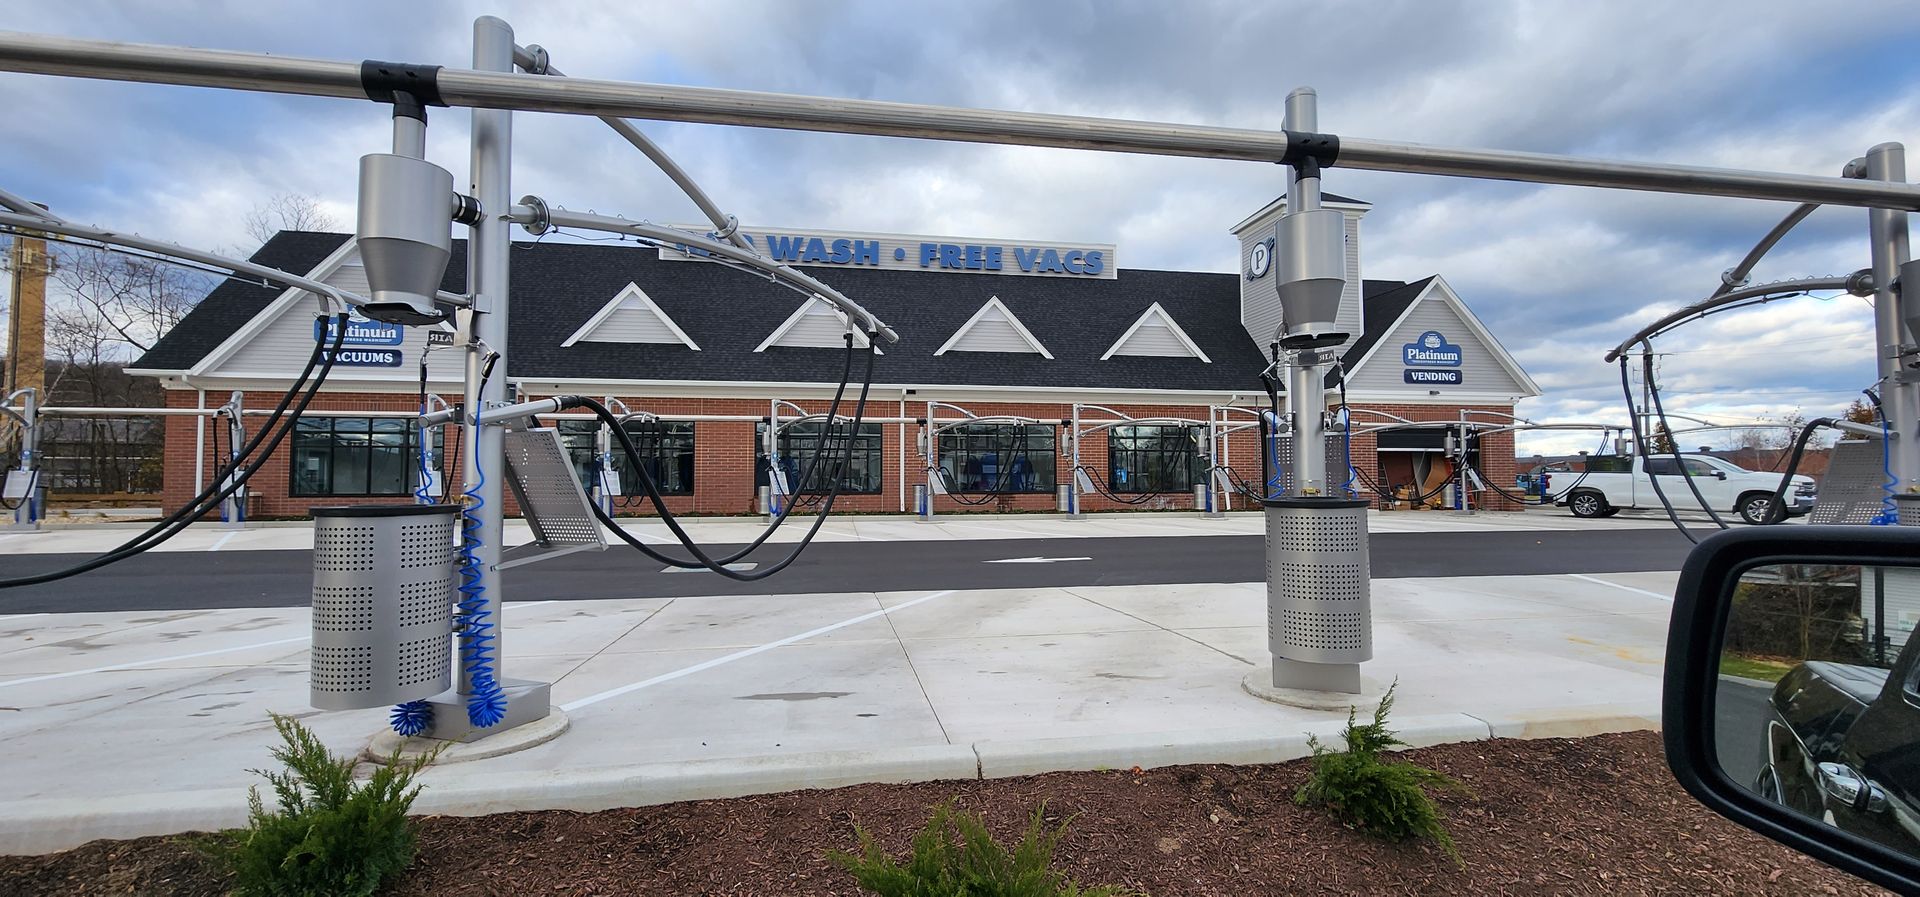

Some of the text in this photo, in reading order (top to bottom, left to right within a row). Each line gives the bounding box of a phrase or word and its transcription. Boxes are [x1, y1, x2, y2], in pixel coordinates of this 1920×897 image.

[766, 235, 880, 266] WASH
[920, 243, 1003, 270] FREE
[1014, 247, 1105, 275] VACS
[326, 323, 397, 338] ltinum
[1407, 348, 1459, 361] Platinum
[1411, 371, 1457, 381] VENDING
